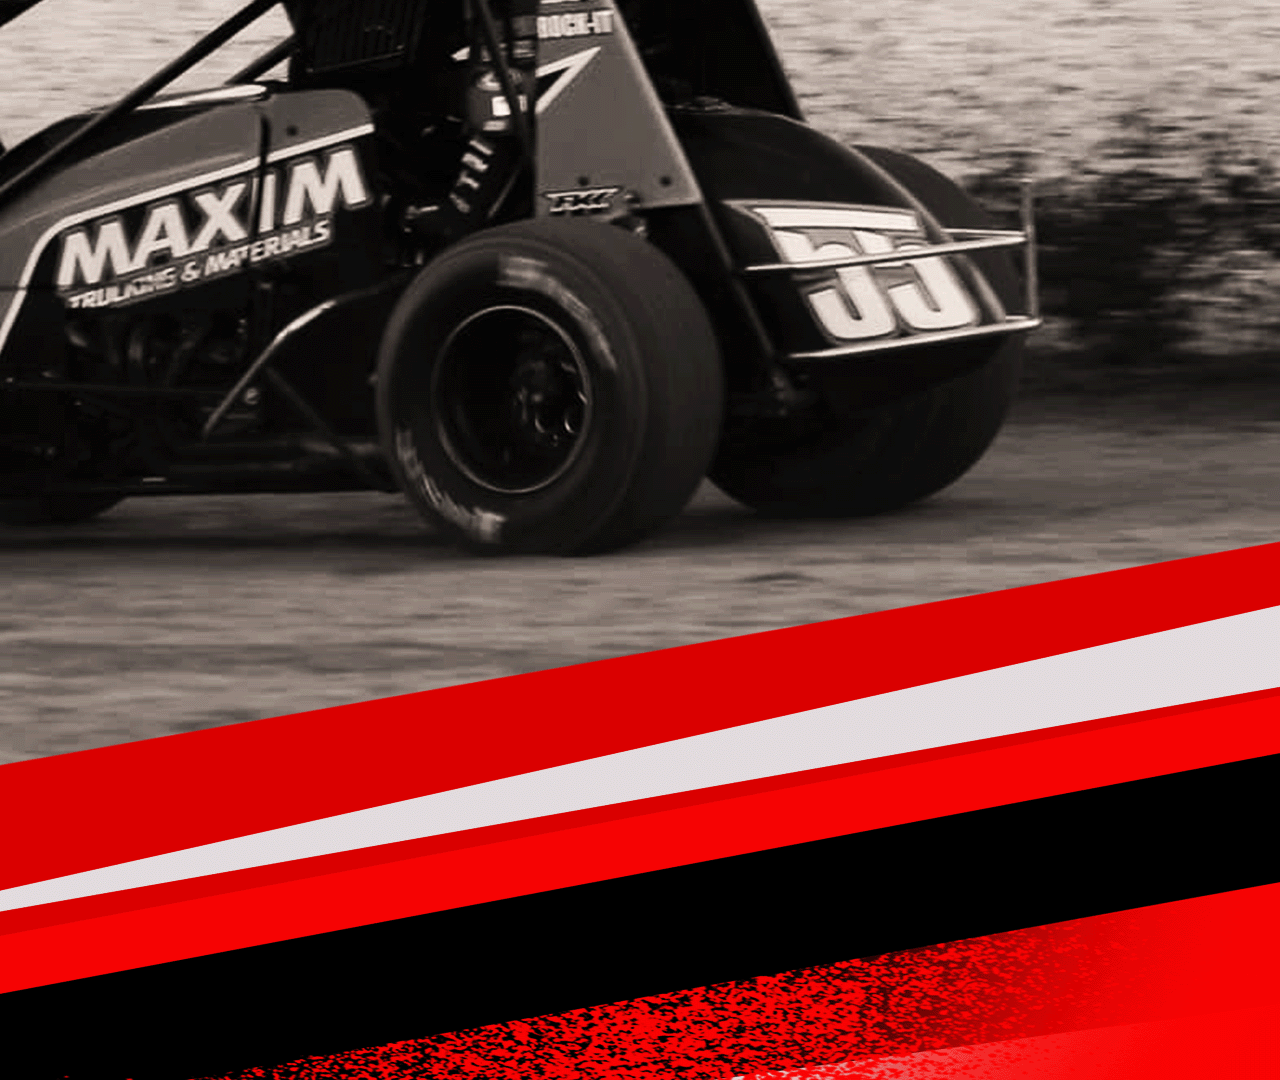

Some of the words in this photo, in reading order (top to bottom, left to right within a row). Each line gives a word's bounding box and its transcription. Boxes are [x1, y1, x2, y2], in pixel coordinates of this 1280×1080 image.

[56, 149, 370, 287] MAXIM
[180, 261, 204, 282] &
[204, 219, 333, 276] MATERIALS
[752, 206, 978, 340] 55
